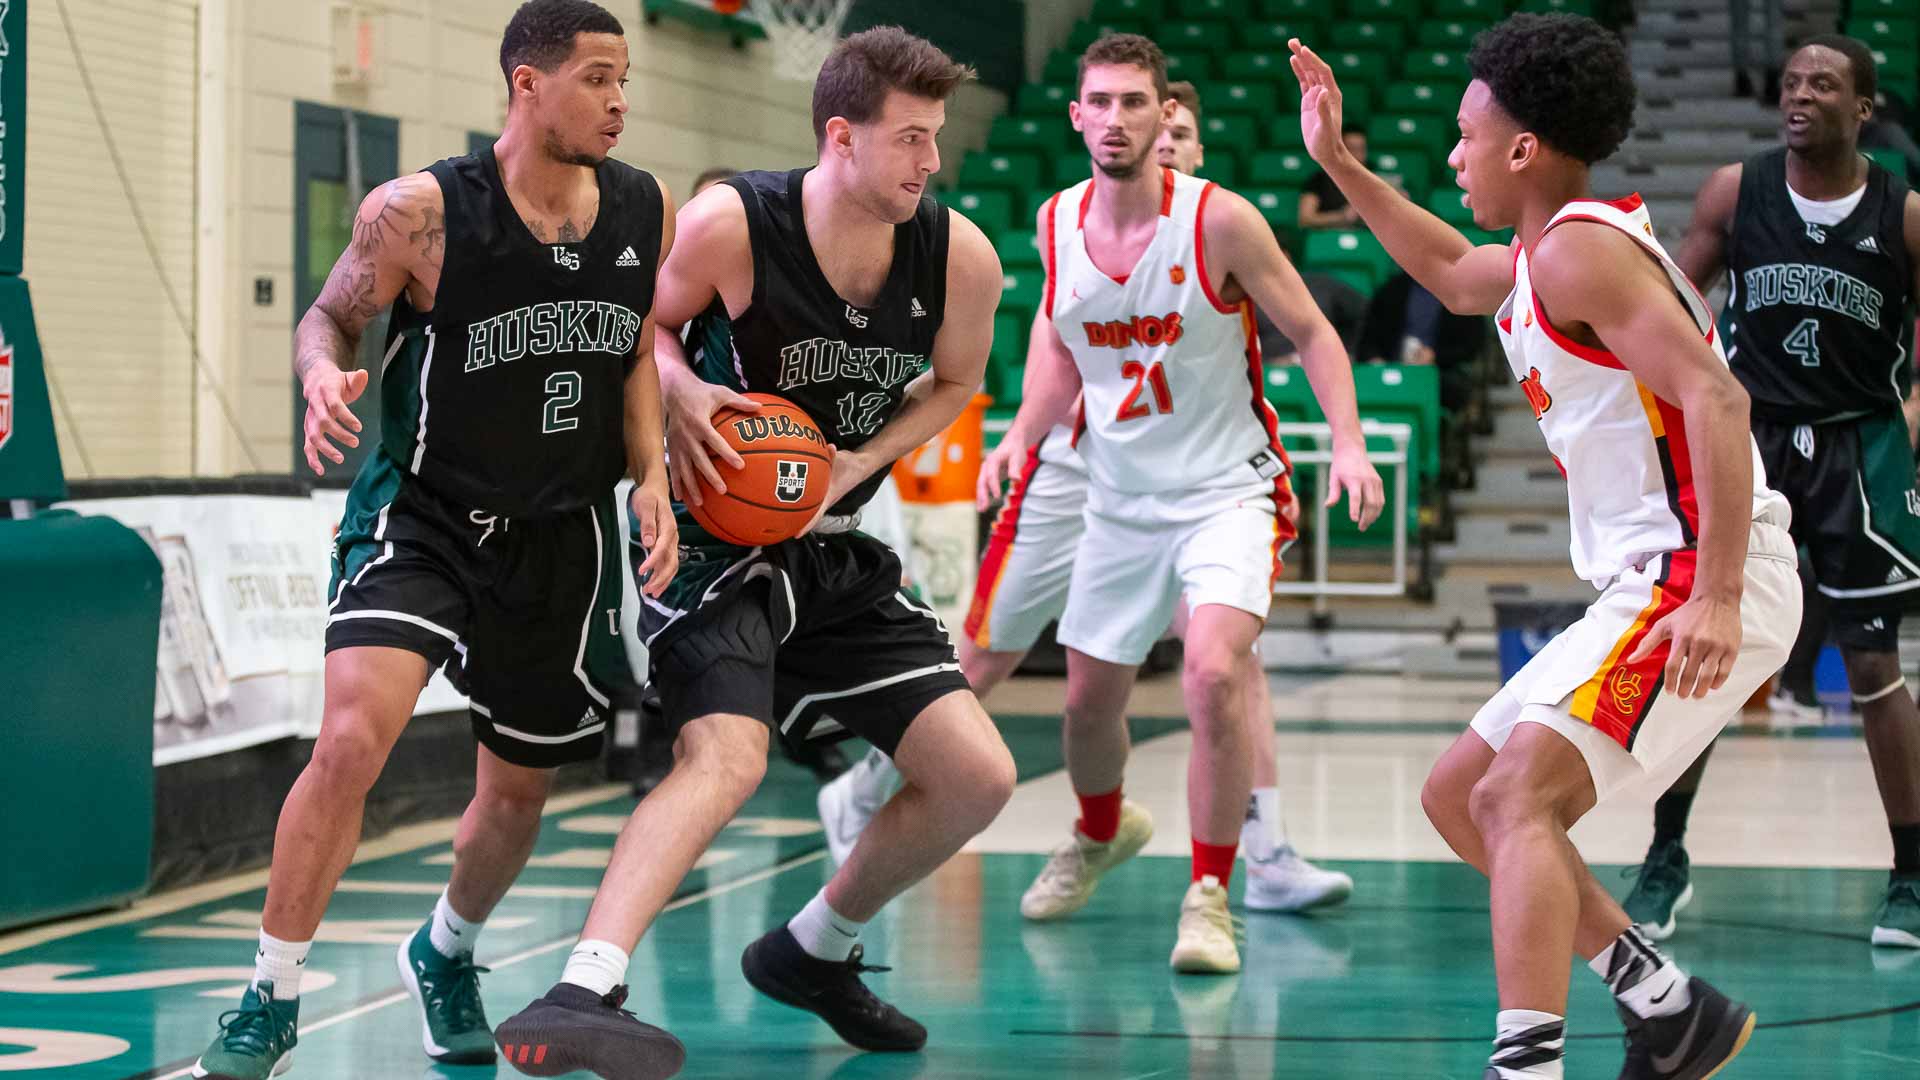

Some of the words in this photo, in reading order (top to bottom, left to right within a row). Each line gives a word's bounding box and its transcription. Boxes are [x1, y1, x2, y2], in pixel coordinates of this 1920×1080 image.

[615, 259, 640, 267] adidas
[1744, 263, 1883, 330] HUSKIES
[464, 300, 641, 373] HUSKIES
[1082, 312, 1184, 348] DINOS
[1782, 318, 1820, 367] 4
[542, 371, 582, 434] 2
[836, 391, 891, 436] 12
[1116, 361, 1174, 422] 21
[733, 414, 827, 449] Wilson
[778, 477, 805, 488] SPORTS
